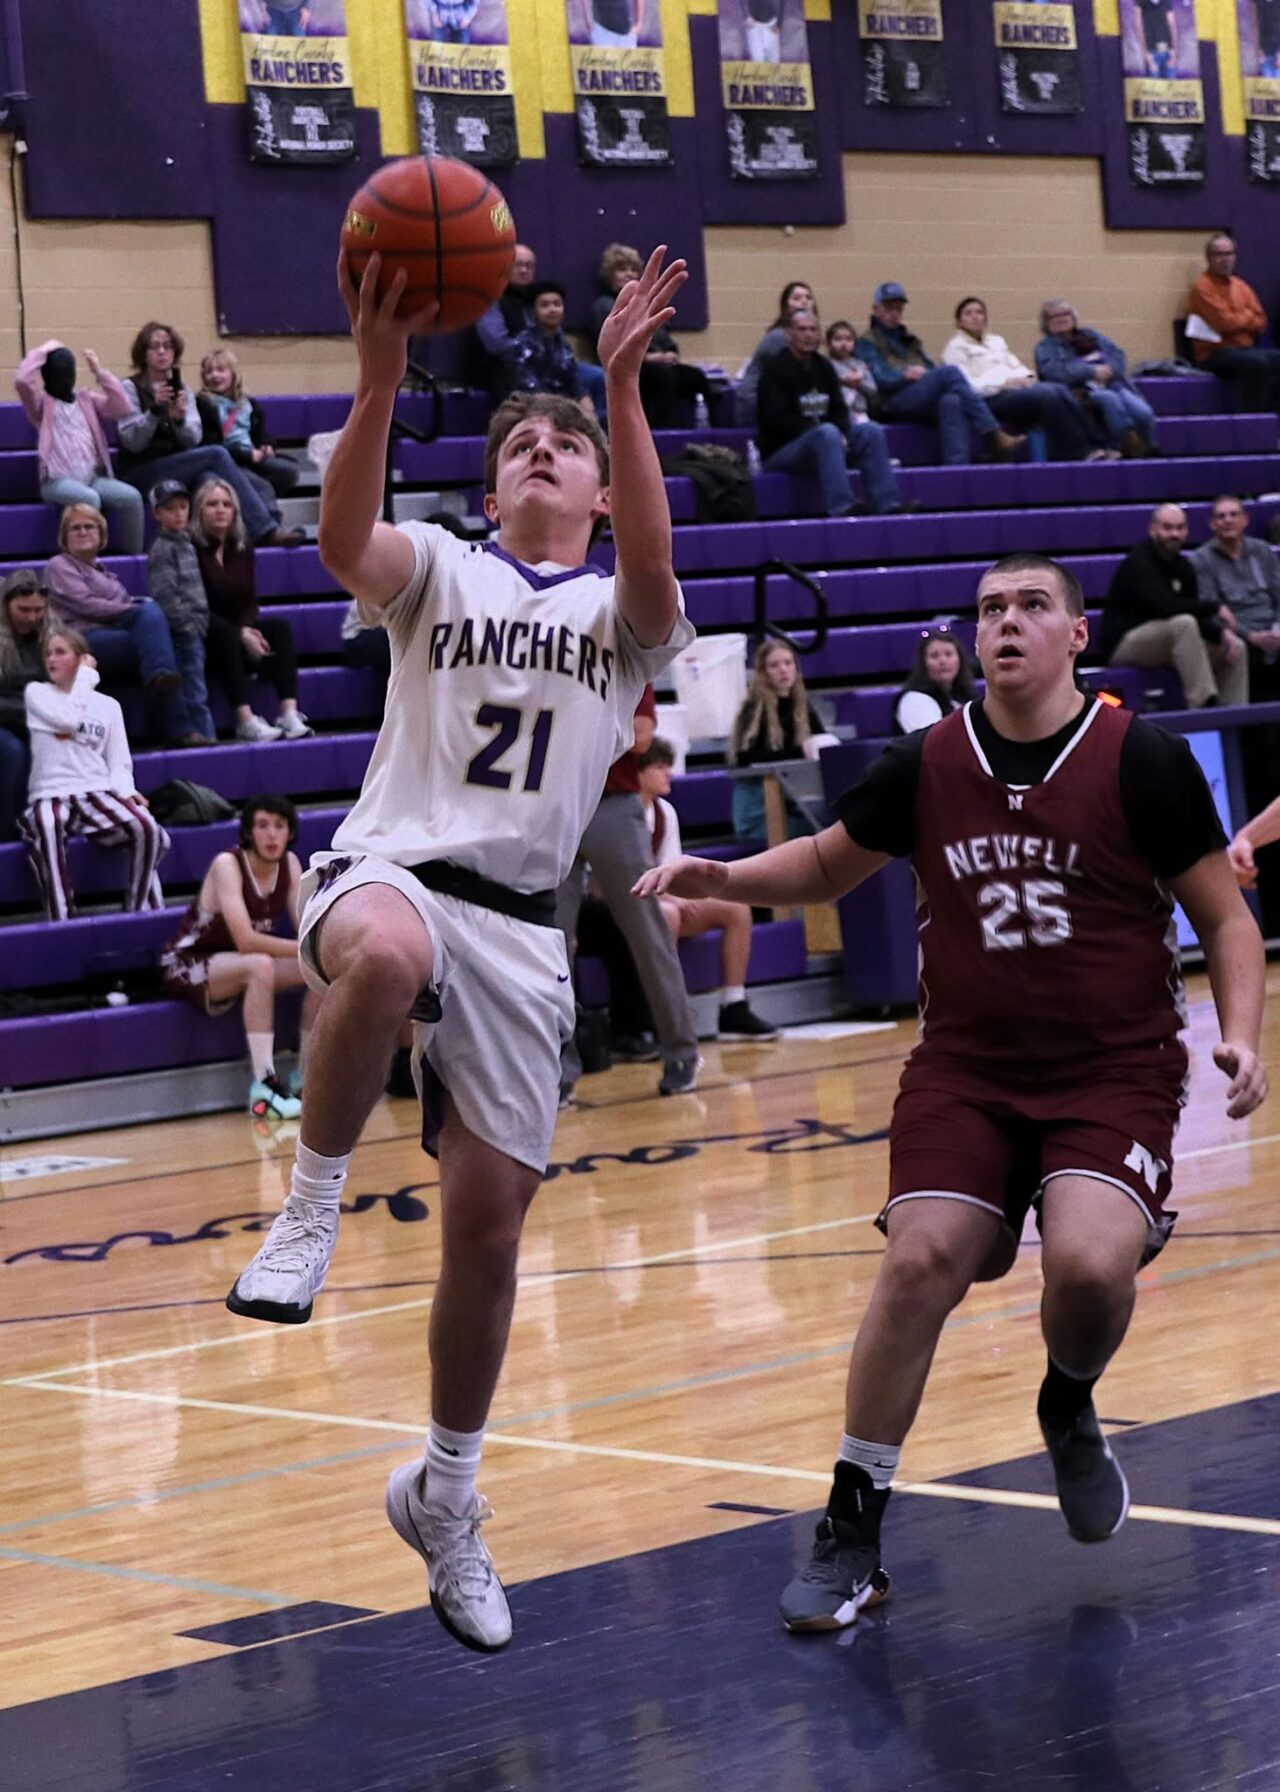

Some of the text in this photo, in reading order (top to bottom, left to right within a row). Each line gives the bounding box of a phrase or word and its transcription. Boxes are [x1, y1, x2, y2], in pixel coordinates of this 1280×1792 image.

[250, 59, 344, 84] RANCHERS
[417, 65, 506, 91] RANCHERS
[578, 70, 662, 91] RANCHERS
[729, 85, 807, 106] RANCHERS
[429, 617, 614, 702] RANCHERS
[464, 700, 554, 793] 21
[1007, 794, 1024, 811] N
[943, 833, 1083, 880] NEWELL
[977, 880, 1073, 951] 25
